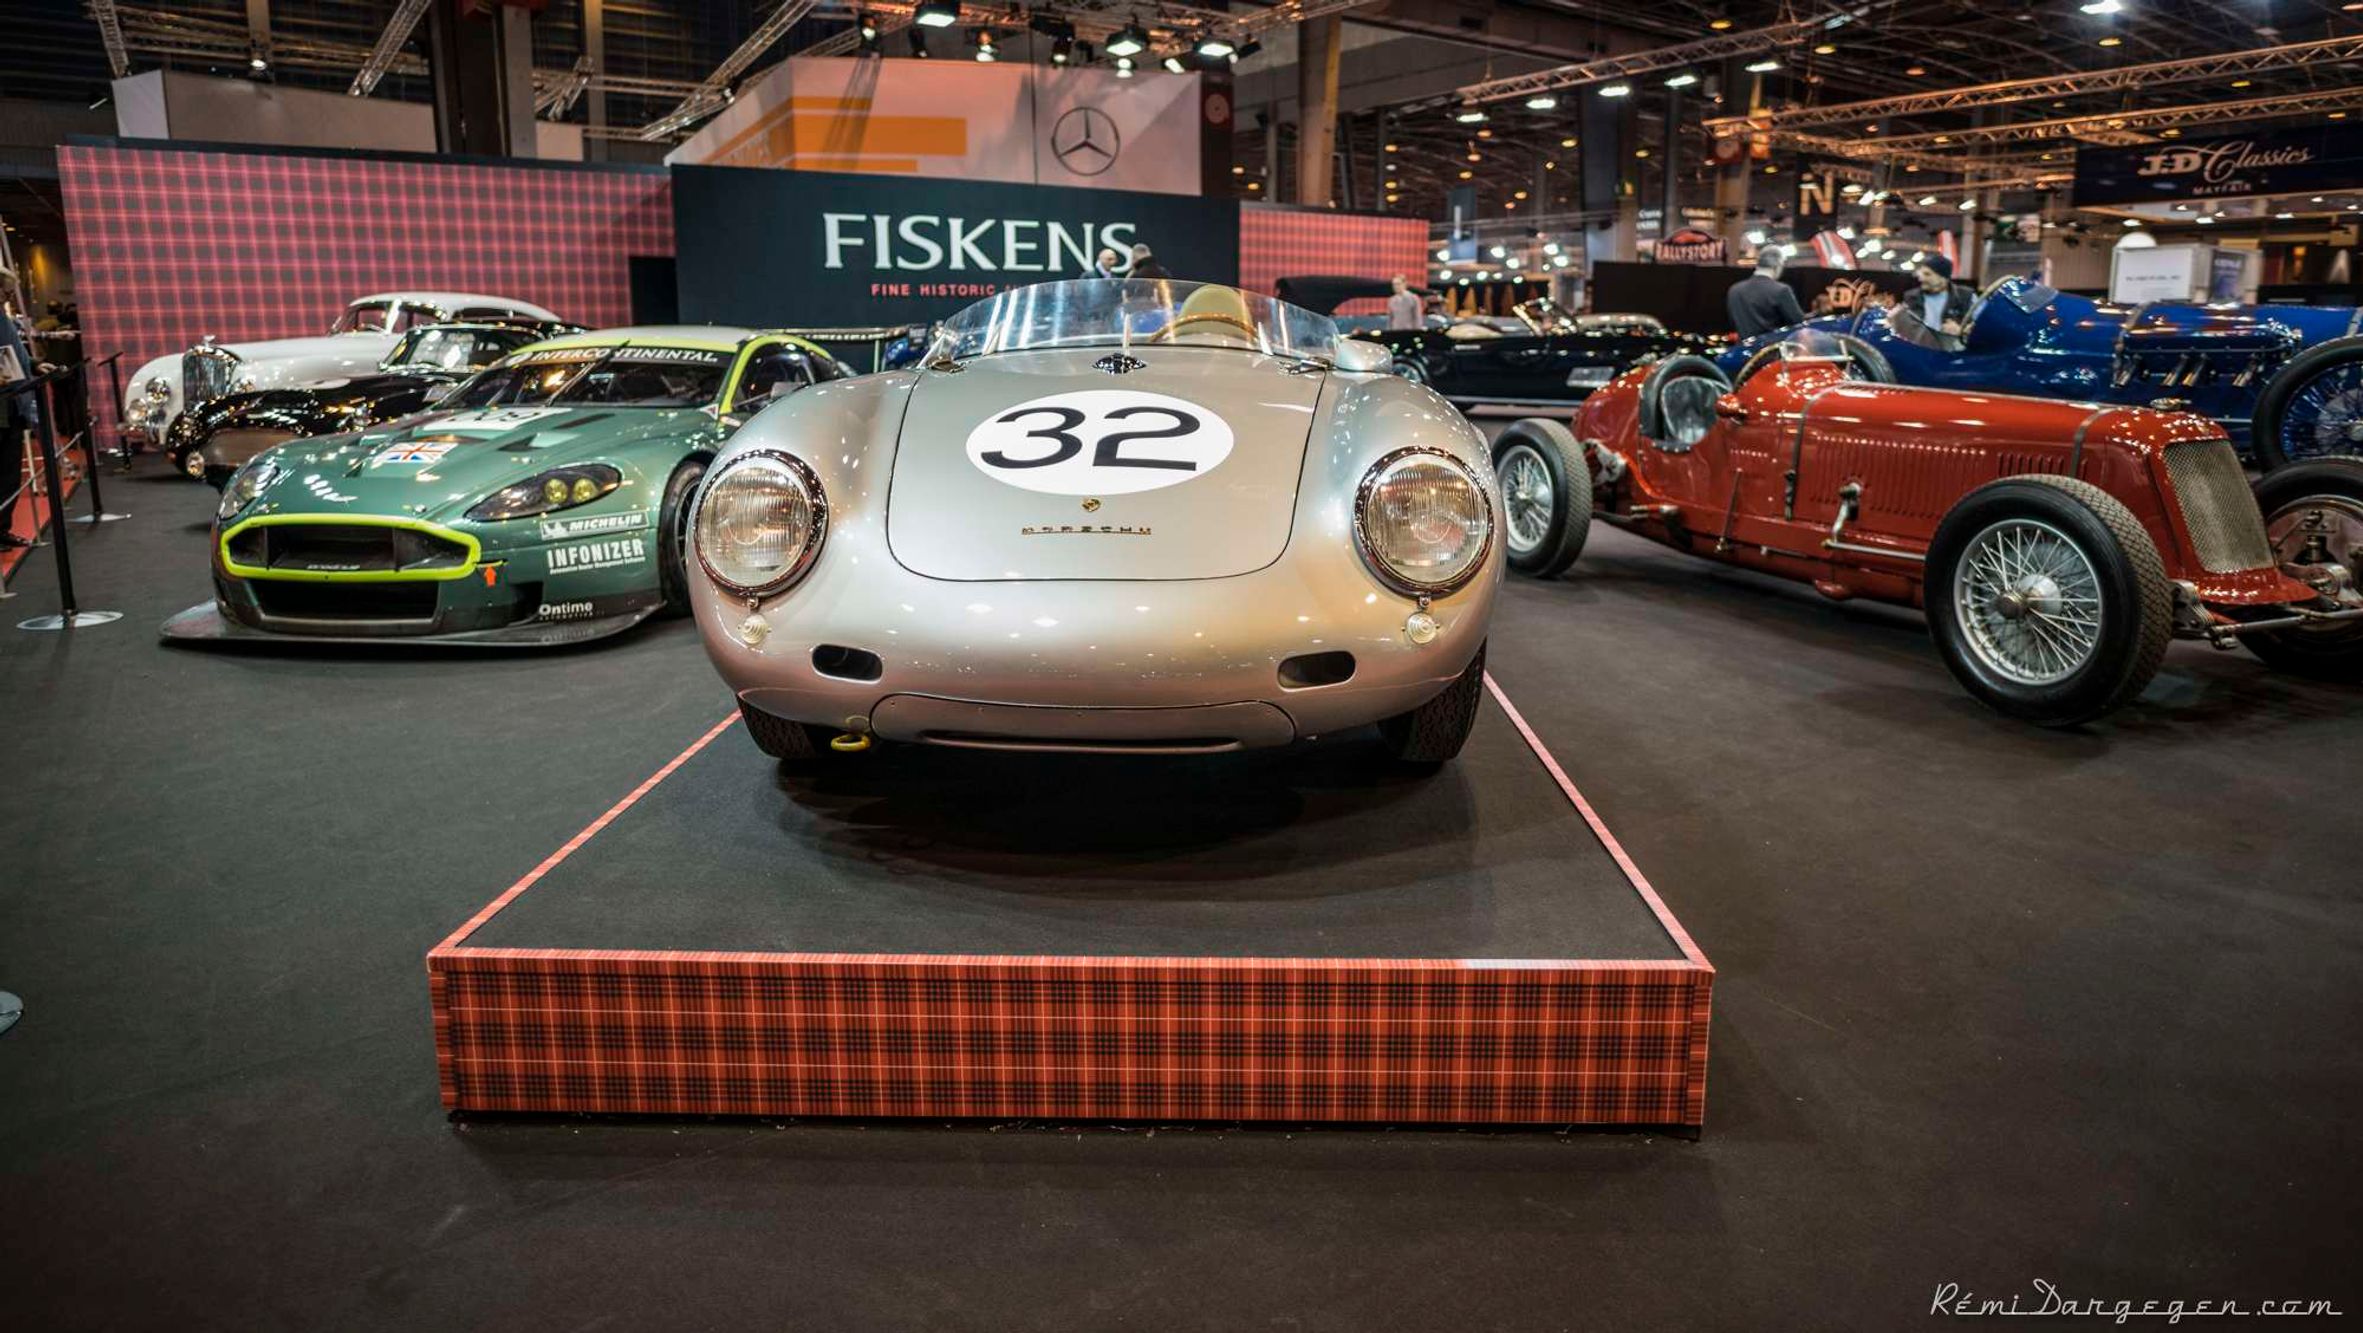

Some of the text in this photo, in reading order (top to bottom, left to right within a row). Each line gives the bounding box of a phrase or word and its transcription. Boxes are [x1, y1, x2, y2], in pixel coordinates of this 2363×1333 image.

[2200, 140, 2316, 184] Classics
[823, 212, 1137, 272] FISKENS
[1654, 240, 1725, 261] RALLYSTORY
[871, 283, 910, 297] FINE
[919, 283, 996, 297] HISTORIC
[981, 406, 1201, 471] 32
[568, 513, 643, 531] MICHELIN
[546, 538, 645, 569] INFONIZER
[539, 601, 593, 616] Ontime
